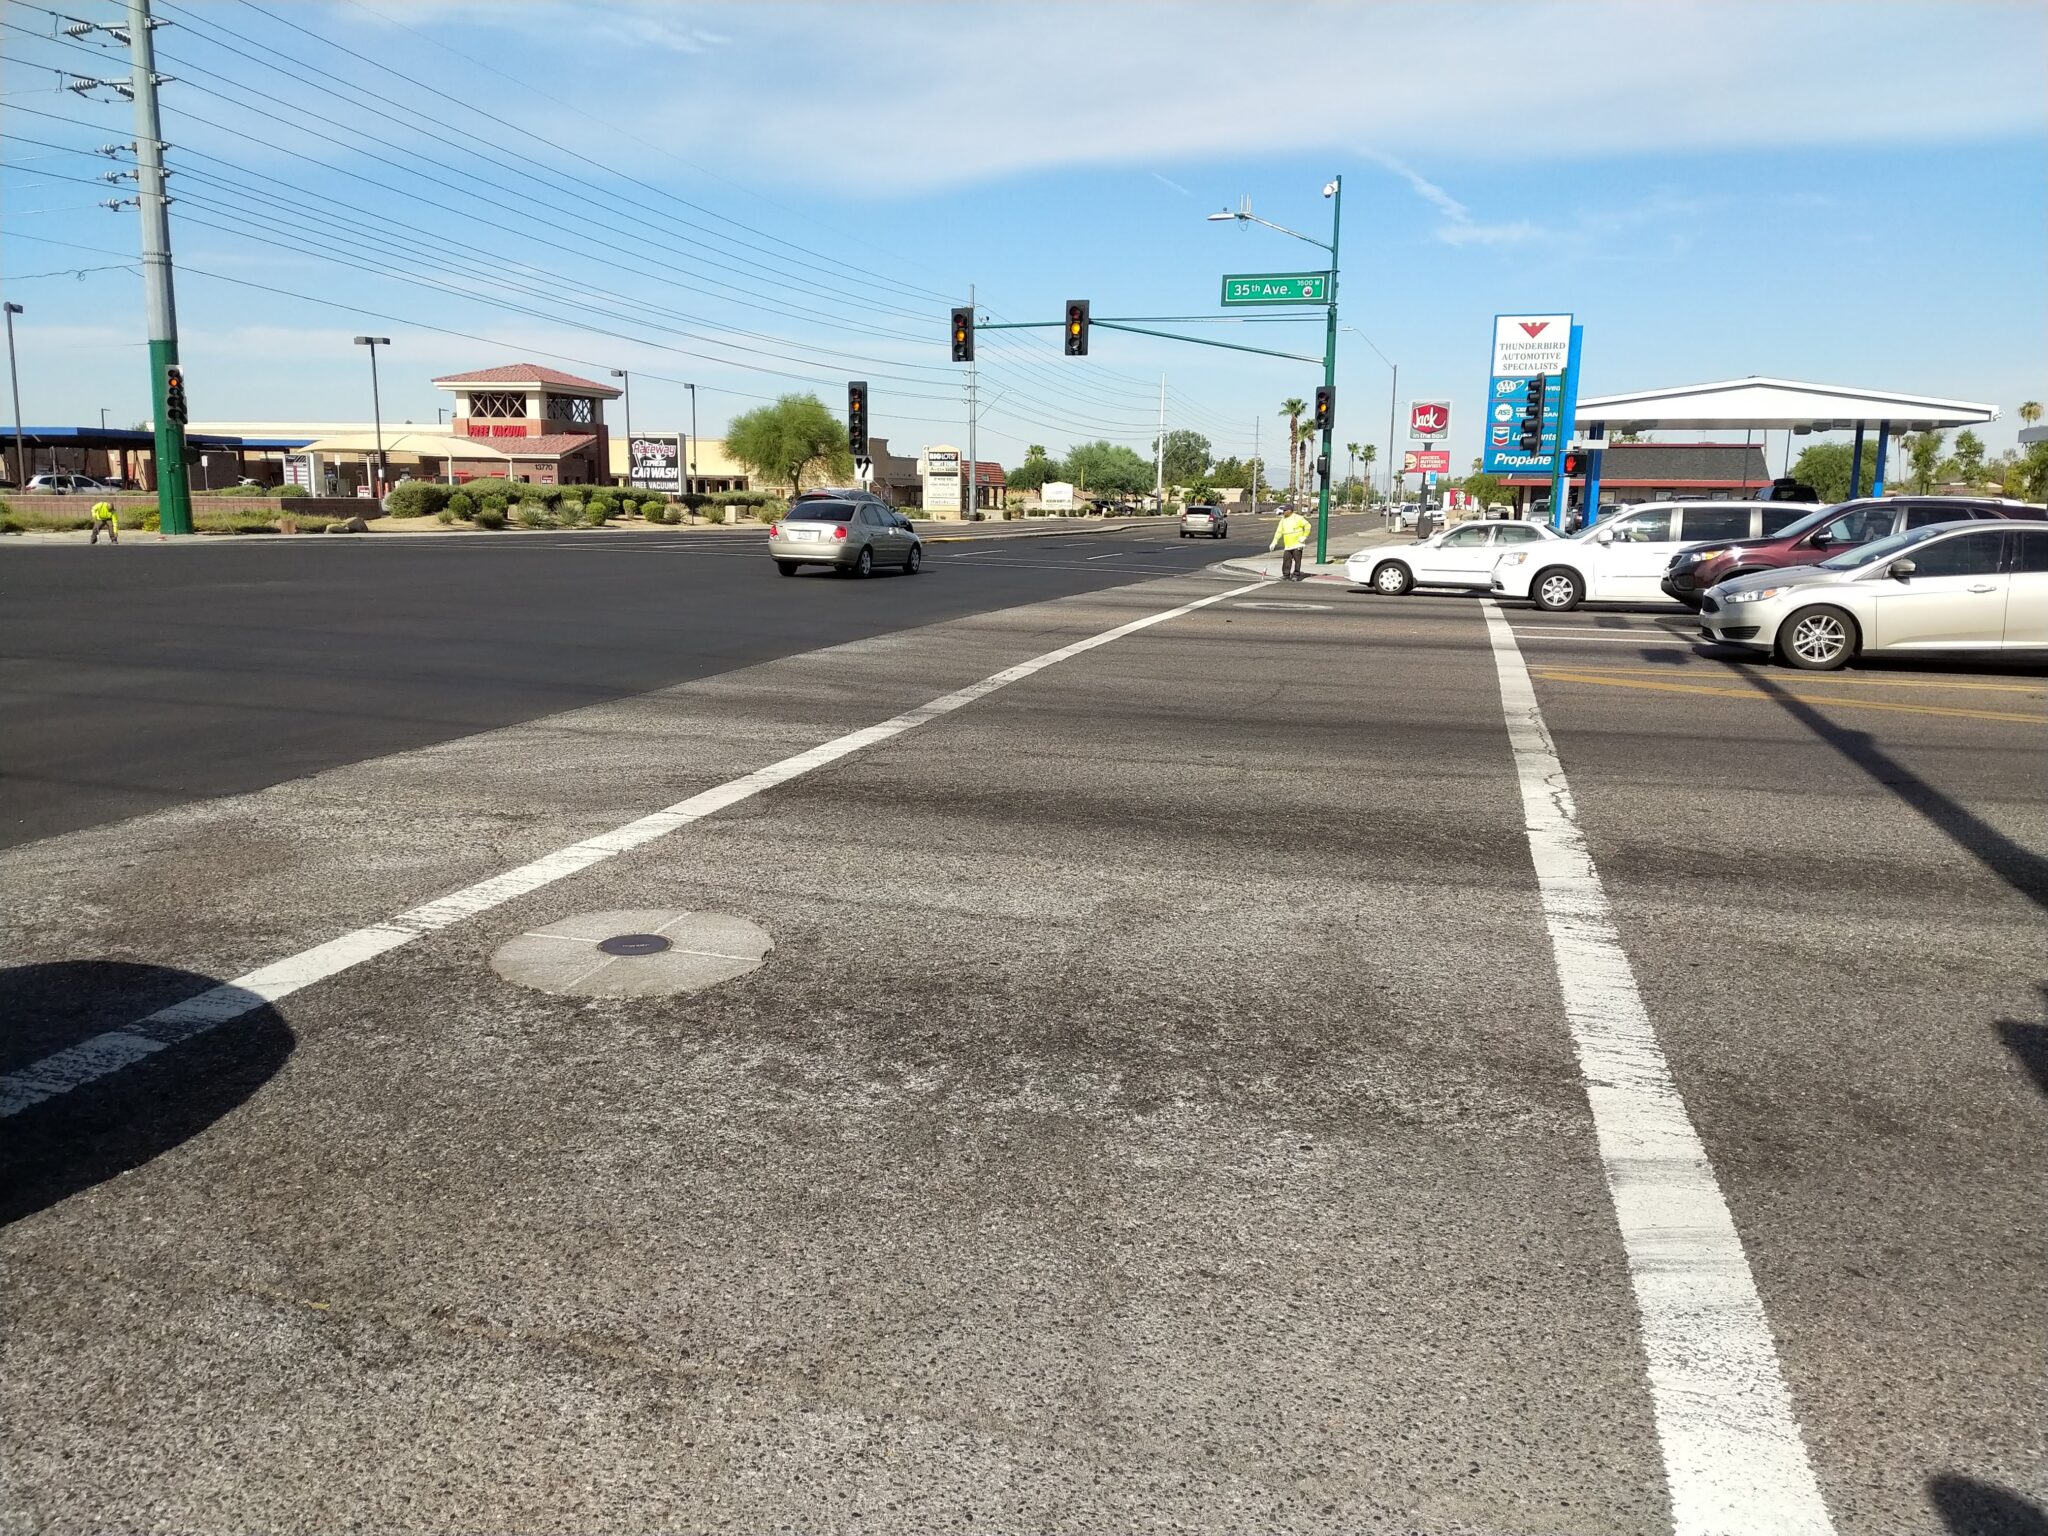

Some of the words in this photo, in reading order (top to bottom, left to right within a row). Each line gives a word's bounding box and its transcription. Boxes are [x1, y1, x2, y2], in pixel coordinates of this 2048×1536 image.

[1262, 284, 1292, 295] Ave.
[1500, 342, 1566, 351] THUNDERBIRD
[1502, 352, 1561, 361] AUTOMOTIVE
[1502, 362, 1558, 371] SPECIALISTS
[1412, 407, 1446, 429] Jack
[469, 425, 490, 437] FREE
[632, 443, 676, 457] Raceway
[1494, 453, 1552, 468] Propane
[632, 467, 651, 478] CAR
[650, 467, 678, 479] WASH
[632, 481, 647, 489] FREE
[648, 481, 679, 490] VACUUMS
